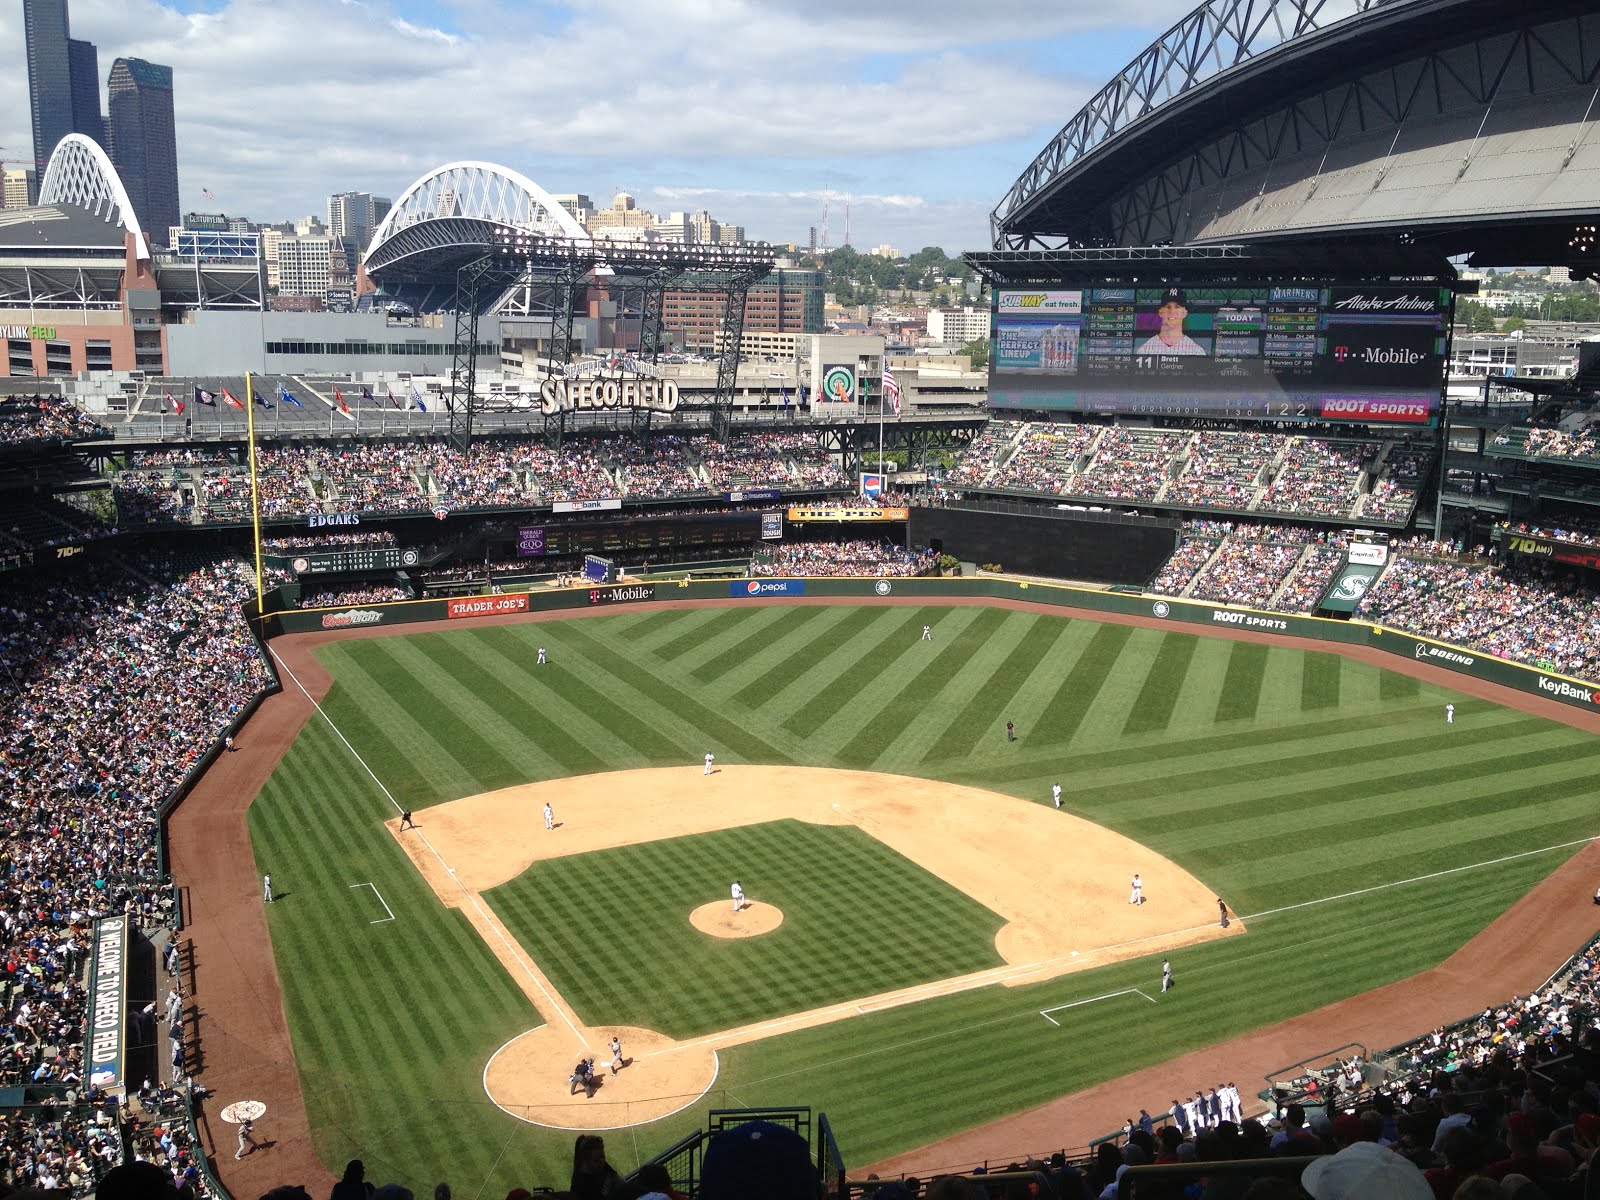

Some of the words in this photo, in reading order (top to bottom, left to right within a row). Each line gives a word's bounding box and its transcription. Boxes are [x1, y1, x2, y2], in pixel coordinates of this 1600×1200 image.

[1000, 293, 1048, 308] SUBWAY
[1273, 287, 1315, 301] MARINERS
[1334, 295, 1383, 311] Alaska
[1382, 295, 1435, 312] Airlines
[1225, 314, 1254, 322] TODAY
[30, 326, 57, 340] FIELD
[1001, 332, 1018, 341] THE
[1000, 340, 1040, 350] PERFECT
[1000, 350, 1031, 358] LINEUP
[1136, 357, 1152, 369] 11
[541, 379, 619, 416] SAFECO
[621, 379, 679, 413] FIELD
[1280, 403, 1289, 416] 2
[1296, 403, 1306, 416] 2
[1324, 398, 1369, 413] ROOT
[1369, 404, 1425, 416] SPORTS
[763, 515, 780, 523] BUILT
[57, 546, 73, 558] 710
[1509, 537, 1536, 554] 710
[761, 583, 787, 593] pepsi
[452, 601, 494, 613] TRADER
[496, 599, 526, 609] JOE'S
[352, 612, 384, 624] LIGHT
[1213, 611, 1247, 624] ROOT
[1246, 617, 1287, 630] SPORTS
[1429, 648, 1474, 666] BOEING
[1538, 676, 1592, 702] KeyBank
[98, 931, 121, 976] WELCOME
[96, 975, 120, 991] TO
[94, 990, 120, 1028] SAFECO
[92, 1029, 118, 1063] FIELD
